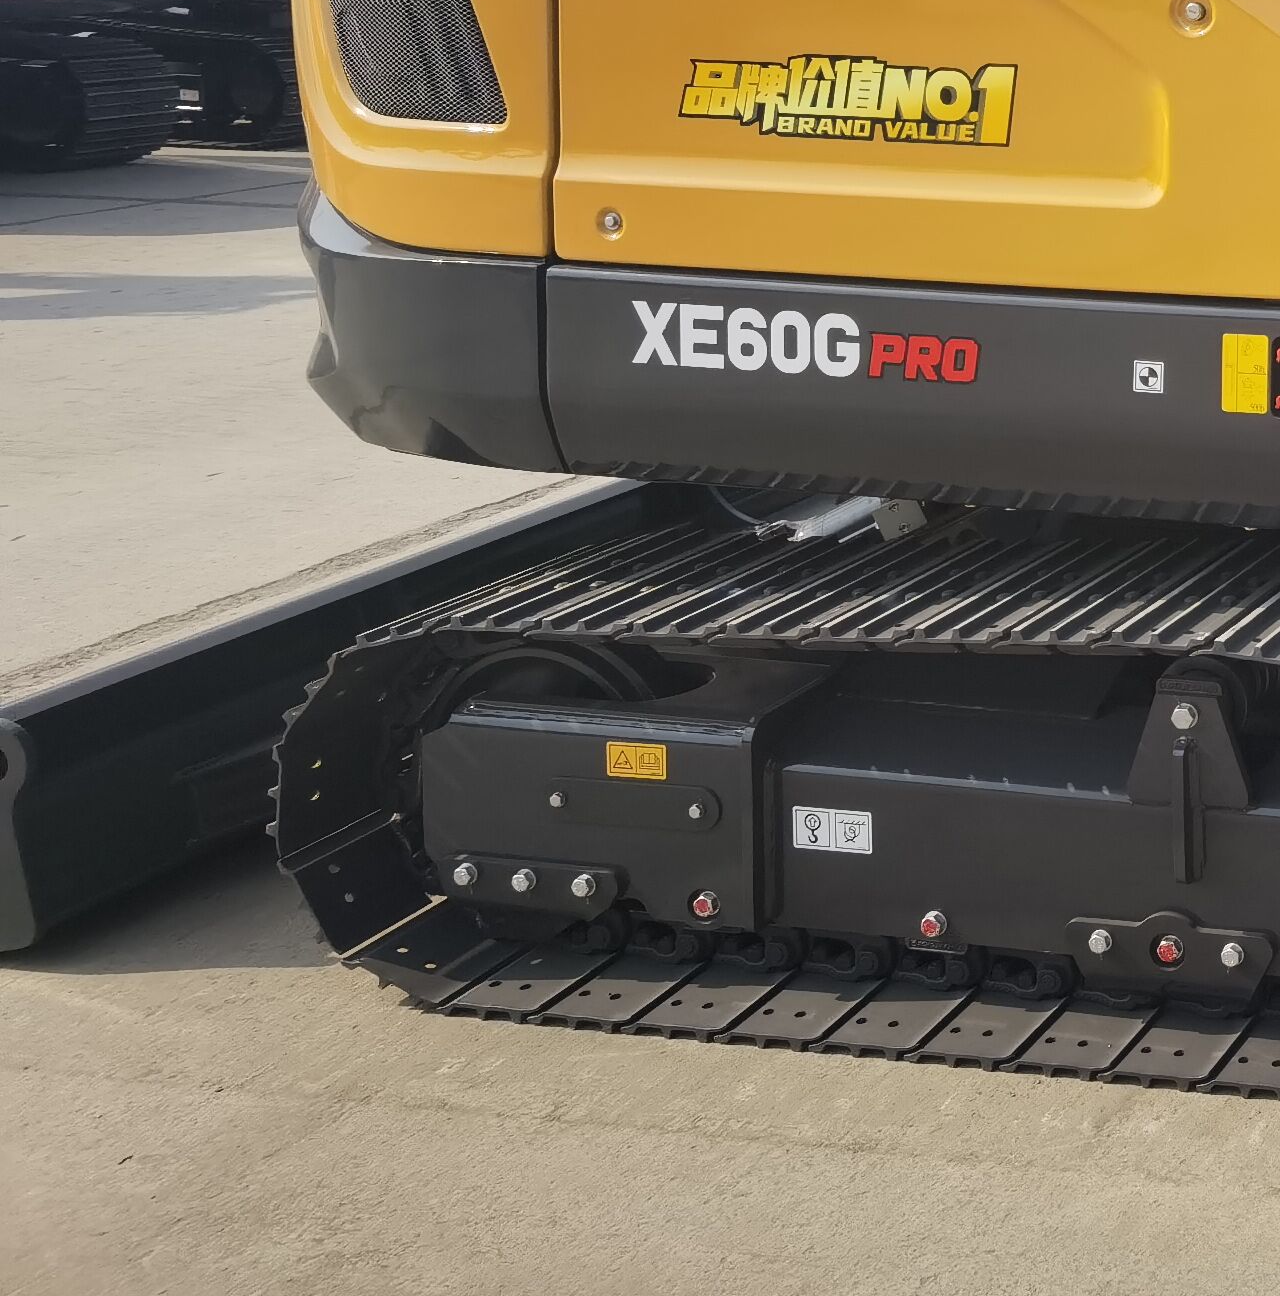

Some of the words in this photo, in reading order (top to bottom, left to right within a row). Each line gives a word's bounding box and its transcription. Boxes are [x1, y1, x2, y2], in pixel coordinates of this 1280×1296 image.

[777, 116, 872, 137] BRAND
[886, 120, 976, 143] VALUE
[631, 300, 861, 378] XE60G
[868, 333, 978, 383] PRO
